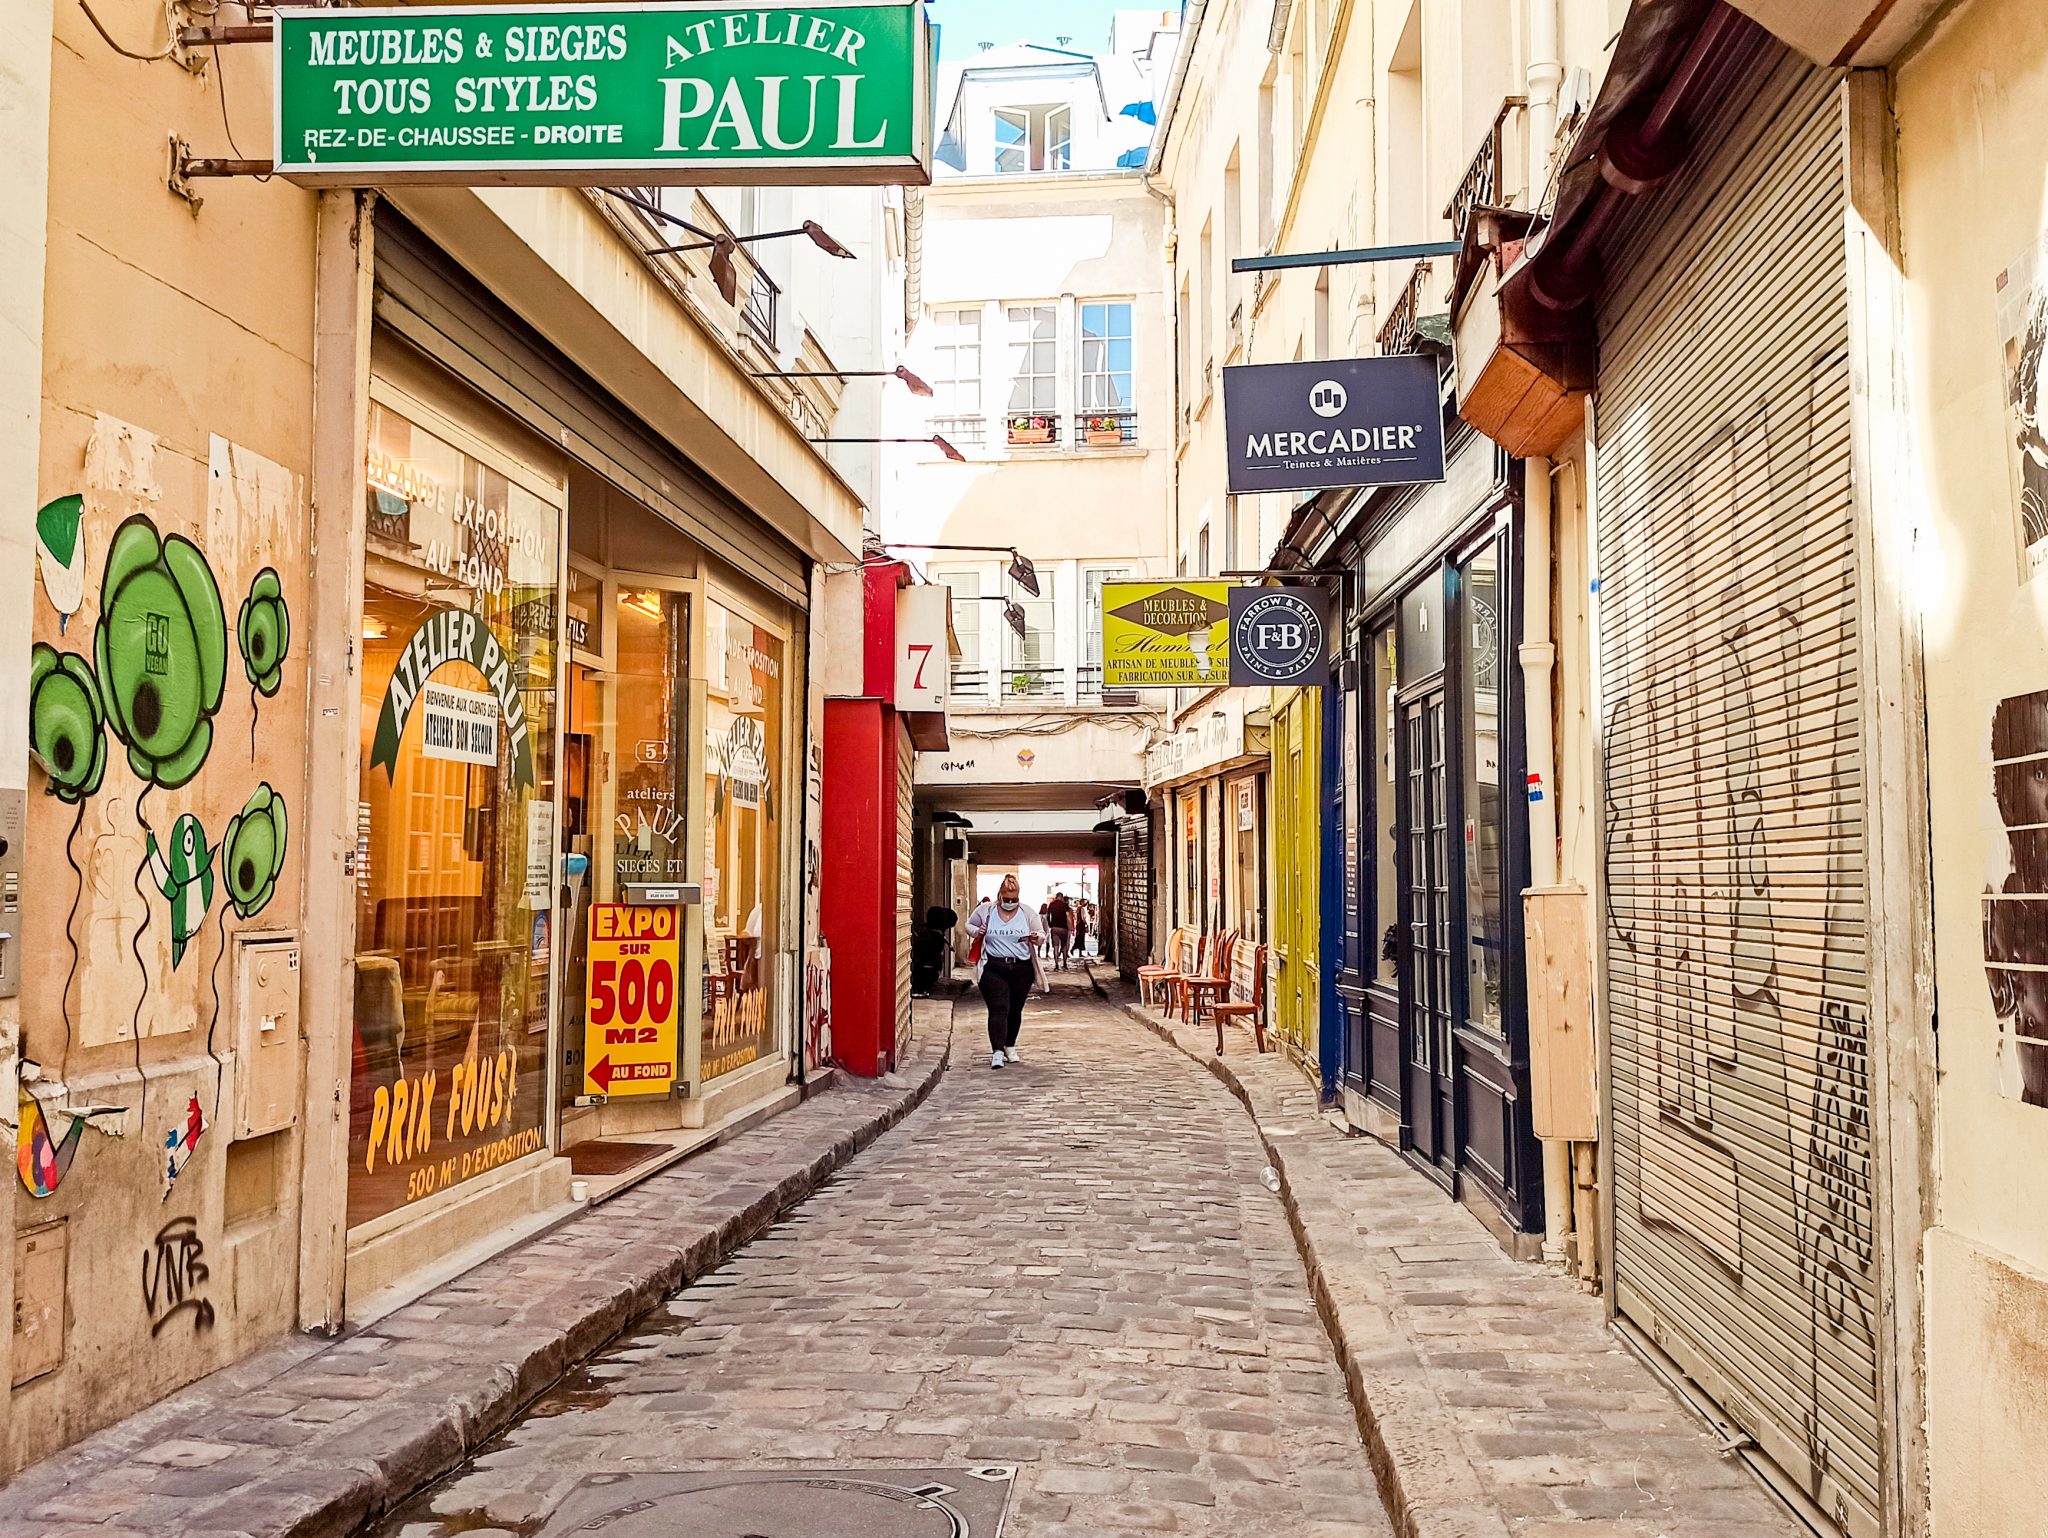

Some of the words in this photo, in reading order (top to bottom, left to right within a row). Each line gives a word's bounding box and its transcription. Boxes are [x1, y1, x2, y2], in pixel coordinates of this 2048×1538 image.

[308, 26, 464, 67] MEUBLES
[475, 33, 494, 59] &
[505, 24, 628, 63] SIEGES
[664, 12, 868, 70] ATELIER
[333, 77, 431, 116] TOUS
[454, 74, 598, 114] STYLES
[653, 74, 888, 153] PAUL
[304, 126, 515, 147] REZ-DE-CHAUSSEE
[534, 124, 623, 144] DROITE
[1282, 460, 1320, 469] Teintes
[1324, 459, 1333, 467] &
[1336, 456, 1381, 466] Matières
[454, 491, 547, 564] EXPOSITION
[425, 539, 450, 576] AU
[458, 551, 503, 597] FOND
[1143, 599, 1195, 611] MEUBLES
[1199, 599, 1207, 611] &
[1143, 612, 1207, 626] DECORATION
[1240, 597, 1281, 631] FARROW
[1295, 604, 1317, 631] BALL
[147, 615, 168, 654] GO
[146, 655, 168, 673] VEGAN
[389, 610, 476, 739] ATELIER
[908, 644, 933, 689] 7
[1106, 659, 1142, 669] ARTISAN
[1146, 658, 1157, 668] DE
[1118, 671, 1174, 682] FABRICATION
[1177, 671, 1194, 681] SUR
[1241, 646, 1270, 673] PAINT
[1288, 646, 1317, 673] PAPER
[426, 690, 455, 710] BIENVENUE
[456, 697, 467, 712] AUX
[469, 700, 486, 717] CLIENTS
[487, 704, 497, 718] DES
[481, 633, 527, 760] PAUL
[425, 713, 453, 749] ATELIERS
[456, 719, 468, 751] BON
[644, 744, 657, 760] 5
[627, 788, 675, 800] ateliers
[615, 804, 684, 845] PAUL
[617, 859, 660, 873] SIEGES
[666, 859, 683, 873] ET
[596, 907, 672, 938] EXPO
[619, 943, 650, 955] SUR
[590, 958, 673, 1025] 500
[605, 1028, 658, 1044] M2
[713, 991, 740, 1050] PRIX
[612, 1065, 631, 1079] AU
[634, 1062, 668, 1078] FOND
[366, 1068, 437, 1175] PRIX
[446, 1044, 519, 1142] FOUS!
[406, 1165, 435, 1201] 500
[462, 1125, 543, 1179] D'EXPOSITION
